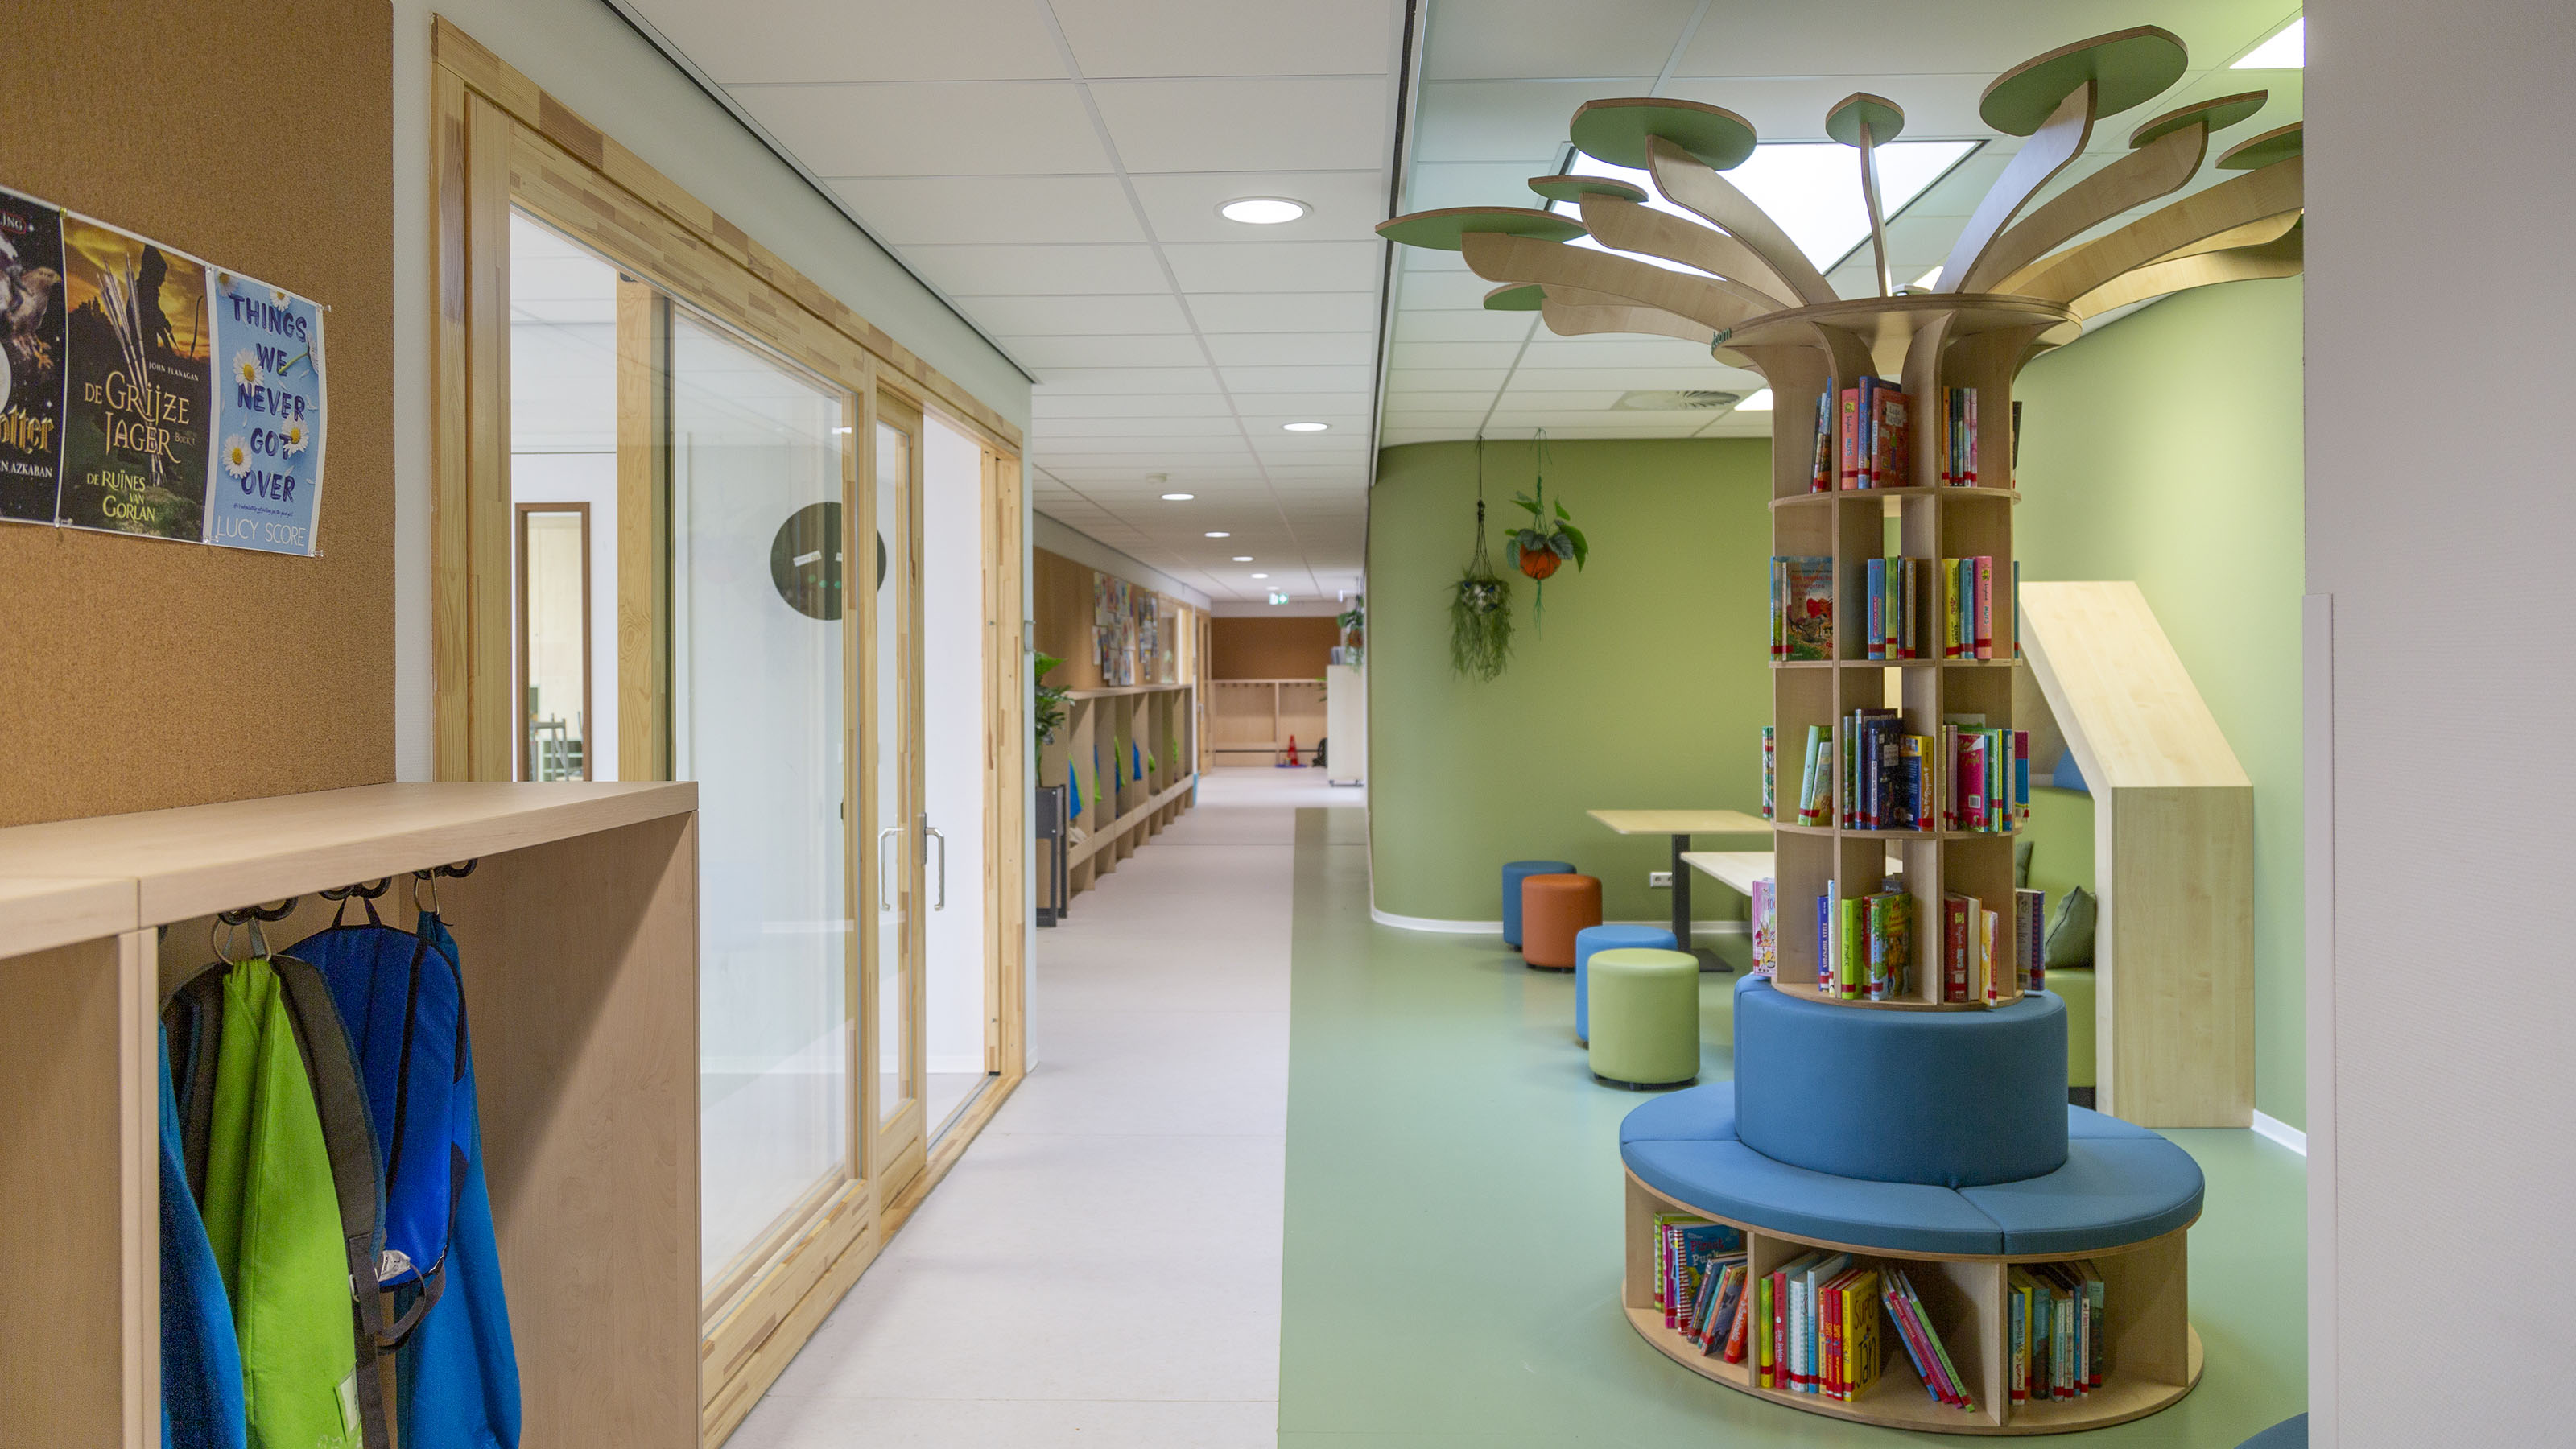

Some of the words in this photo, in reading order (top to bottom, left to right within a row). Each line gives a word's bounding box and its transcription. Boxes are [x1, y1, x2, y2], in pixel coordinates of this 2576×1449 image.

[0, 213, 23, 231] ING
[229, 292, 307, 343] THINGS
[149, 361, 166, 372] JOHN
[167, 367, 199, 382] FLANAGAN
[256, 342, 287, 377] WE
[85, 382, 103, 404] DE
[237, 383, 305, 422] NEVER
[105, 411, 181, 464] JAGER
[250, 427, 293, 460] GOT
[11, 463, 53, 477] AZKABAN
[86, 473, 100, 485] DE
[101, 469, 146, 492] RUÏNES
[129, 493, 145, 505] VAN
[242, 469, 295, 503] OVER
[102, 495, 155, 524] GORLAN
[217, 515, 259, 540] LUCY
[264, 522, 307, 547] SCORE
